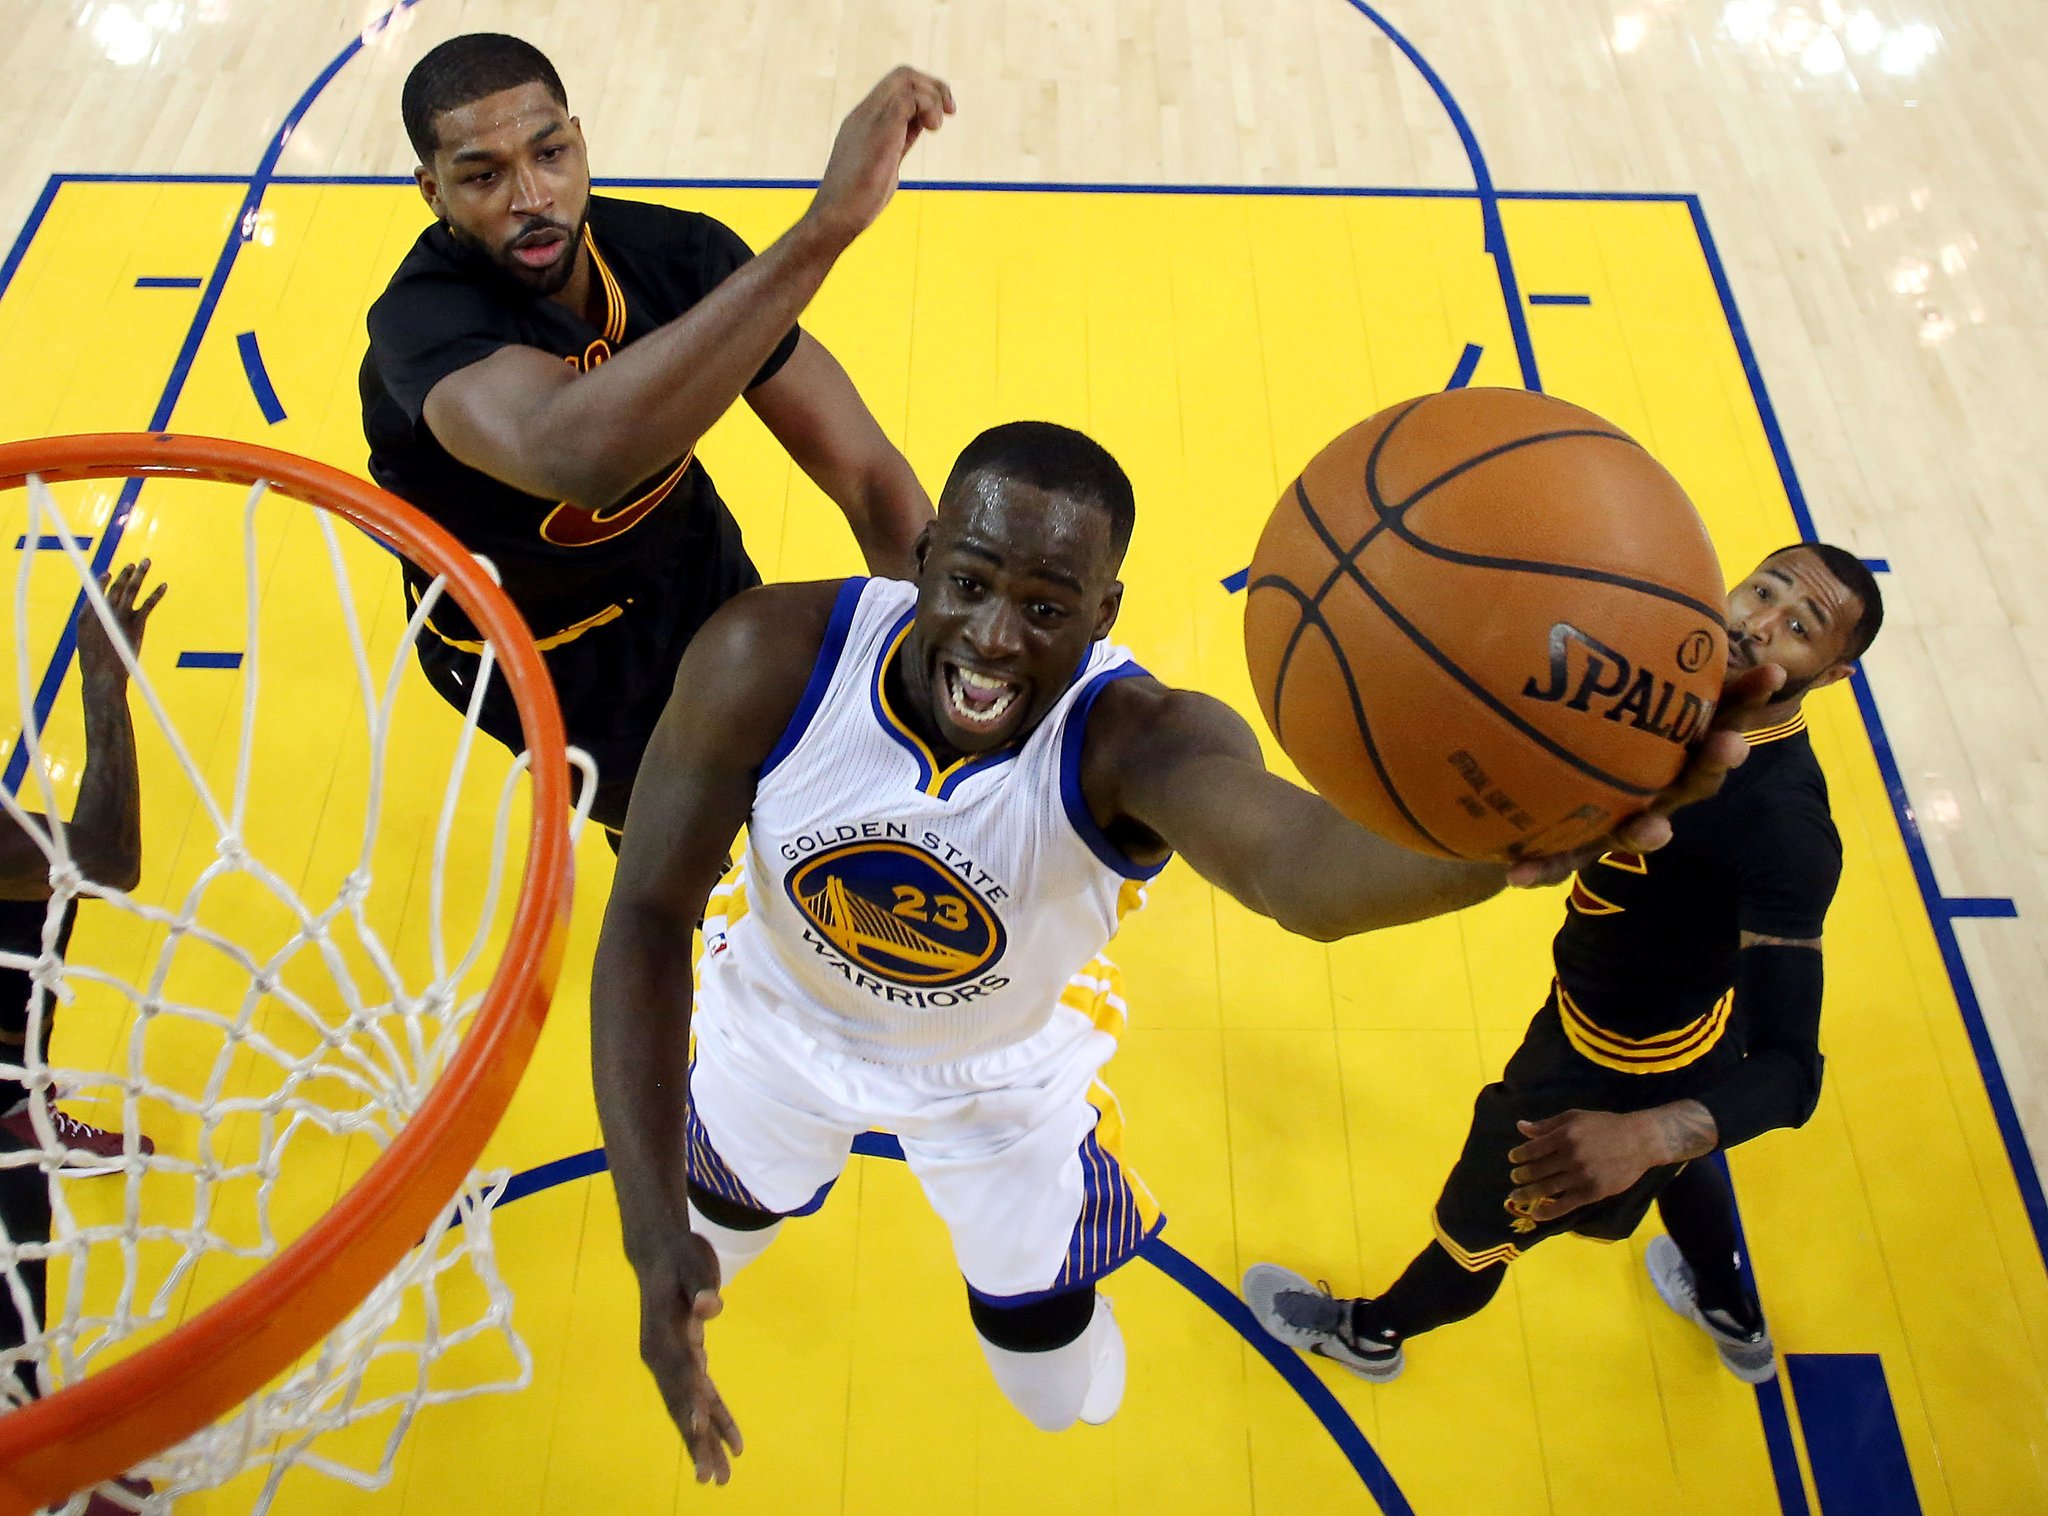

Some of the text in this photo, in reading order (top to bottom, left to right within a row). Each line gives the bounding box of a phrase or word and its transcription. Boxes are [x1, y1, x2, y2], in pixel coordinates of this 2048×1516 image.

[1521, 620, 1711, 745] SPALD
[780, 822, 1009, 905] GOLDEN STATE
[891, 884, 969, 933] 23
[802, 929, 1011, 1009] WARRIORS
